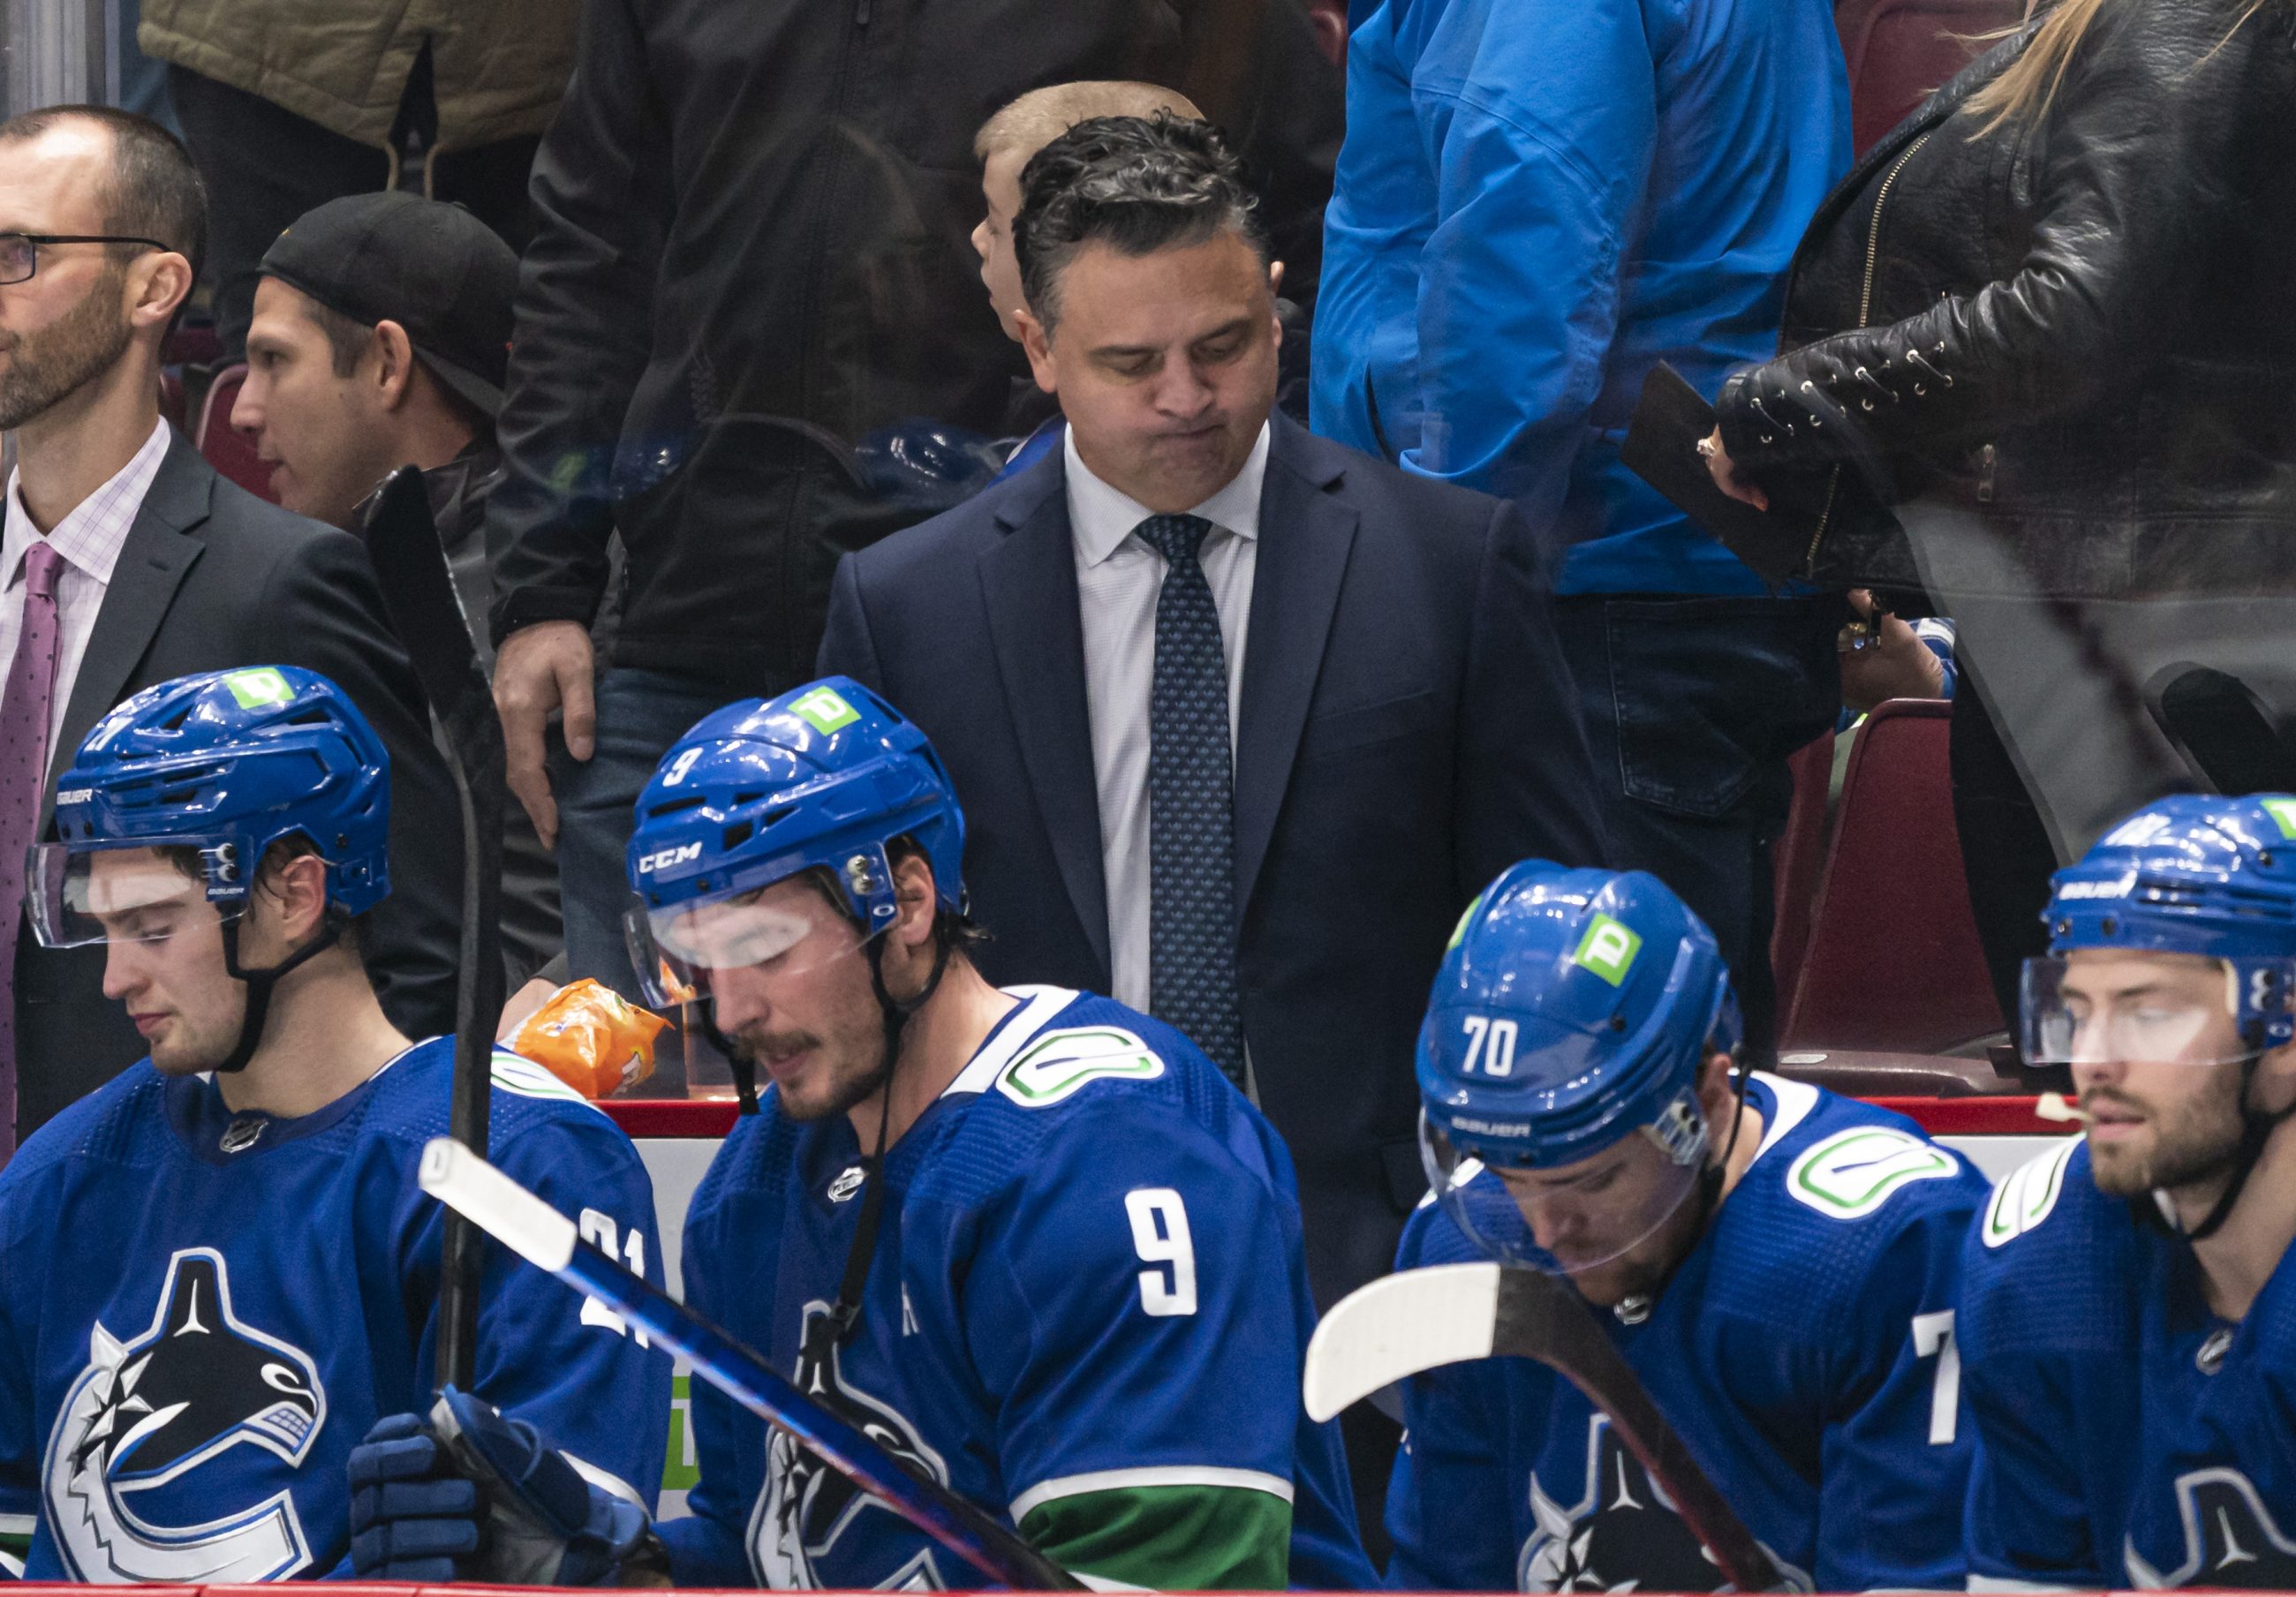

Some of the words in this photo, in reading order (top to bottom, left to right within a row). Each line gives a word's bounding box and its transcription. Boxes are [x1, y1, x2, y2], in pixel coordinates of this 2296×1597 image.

[662, 747, 704, 787] 9
[638, 841, 703, 874] CCM
[1462, 1015, 1518, 1077] 70
[1124, 1187, 1197, 1316] 9
